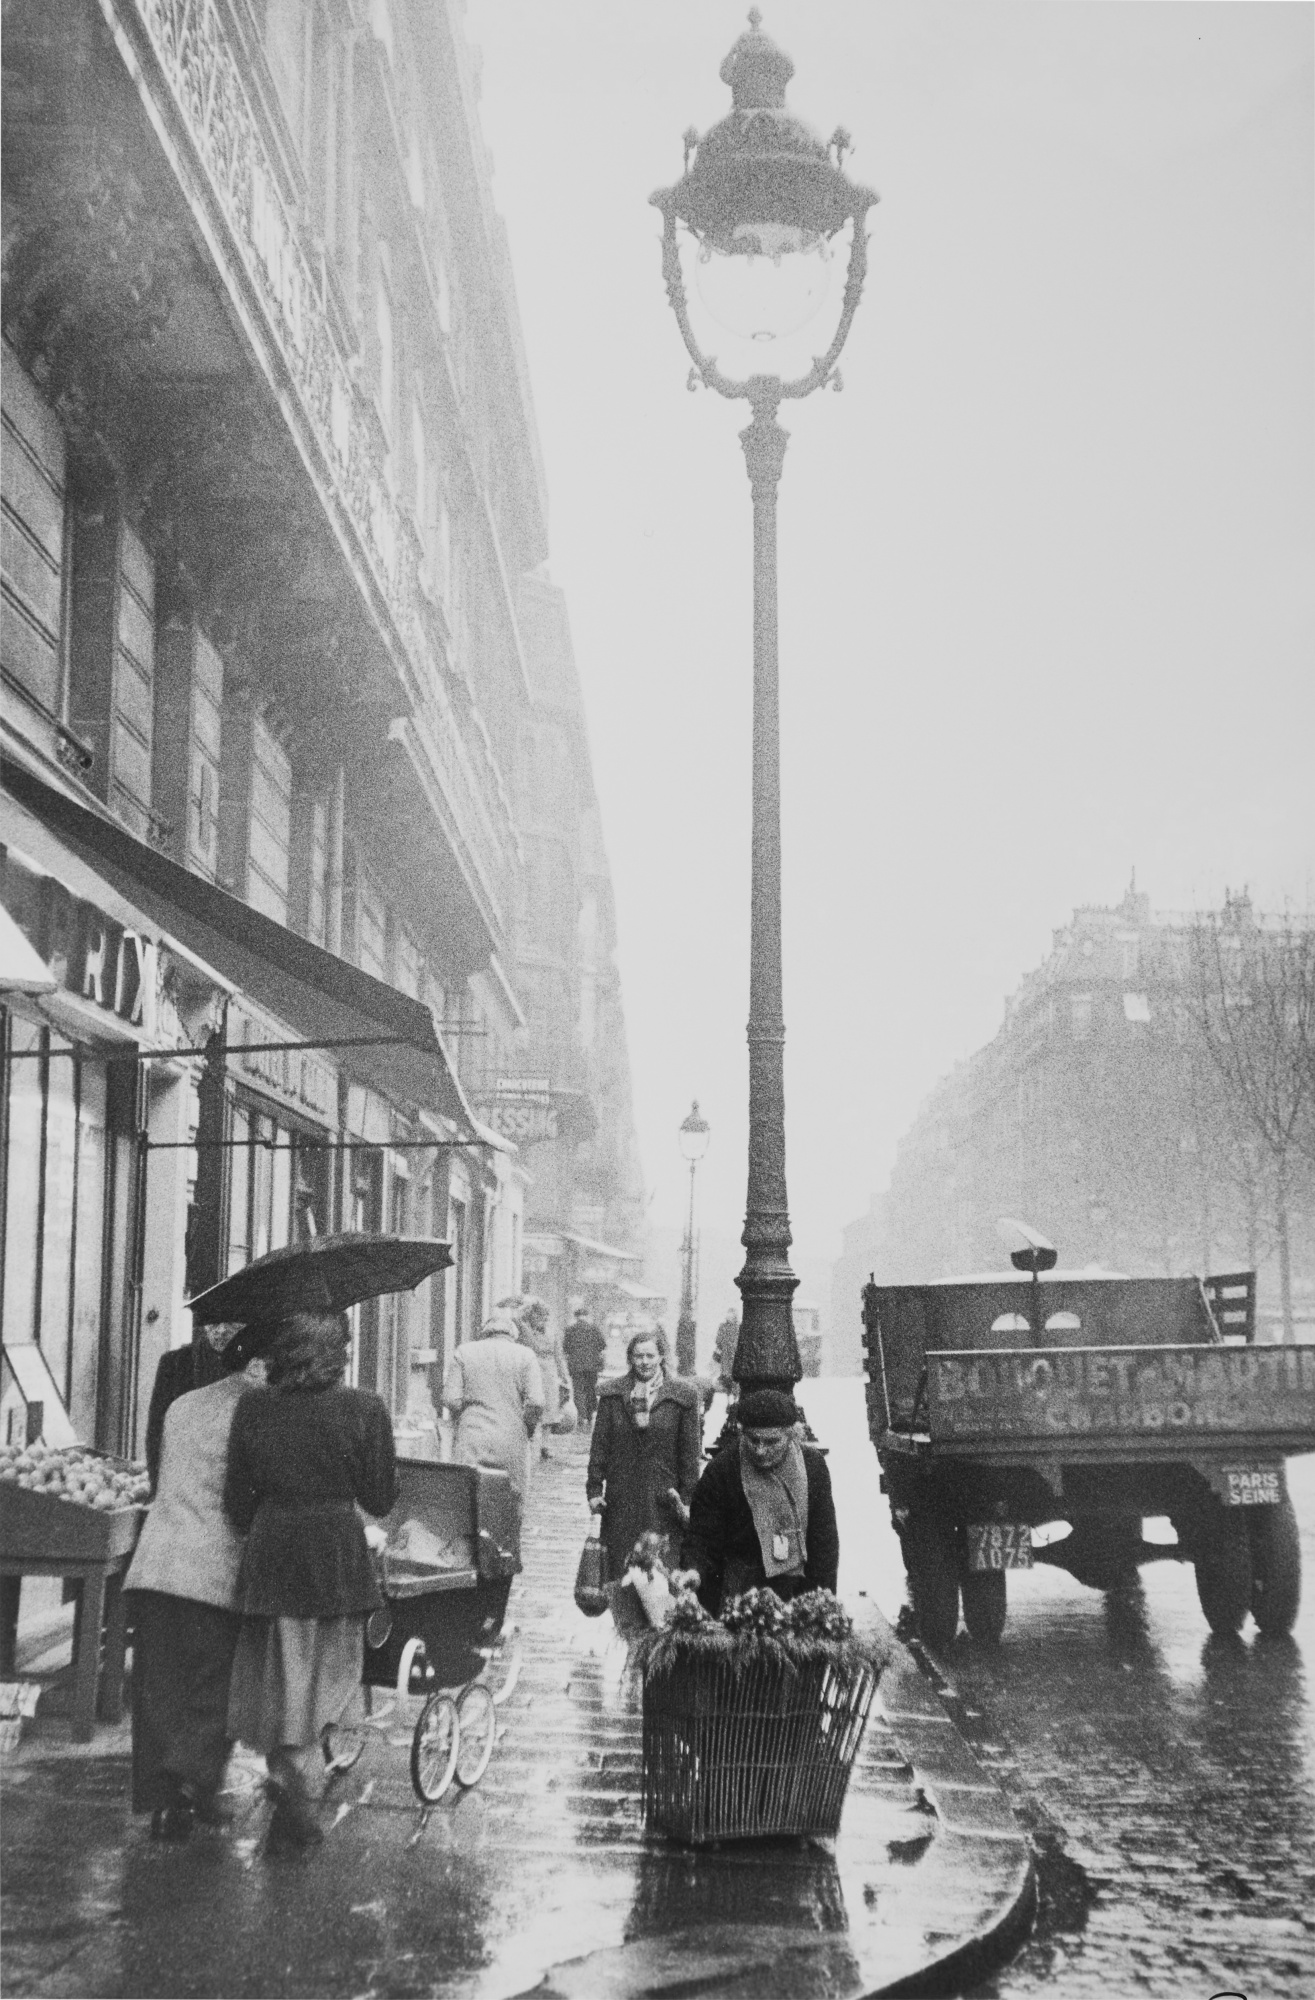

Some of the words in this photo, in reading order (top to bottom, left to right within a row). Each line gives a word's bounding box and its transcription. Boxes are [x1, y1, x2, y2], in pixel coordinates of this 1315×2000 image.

[475, 1106, 558, 1138] RESSING
[938, 1355, 1136, 1401] BOUQUET
[1228, 1473, 1279, 1488] PARIS
[1229, 1489, 1280, 1504] SEINE
